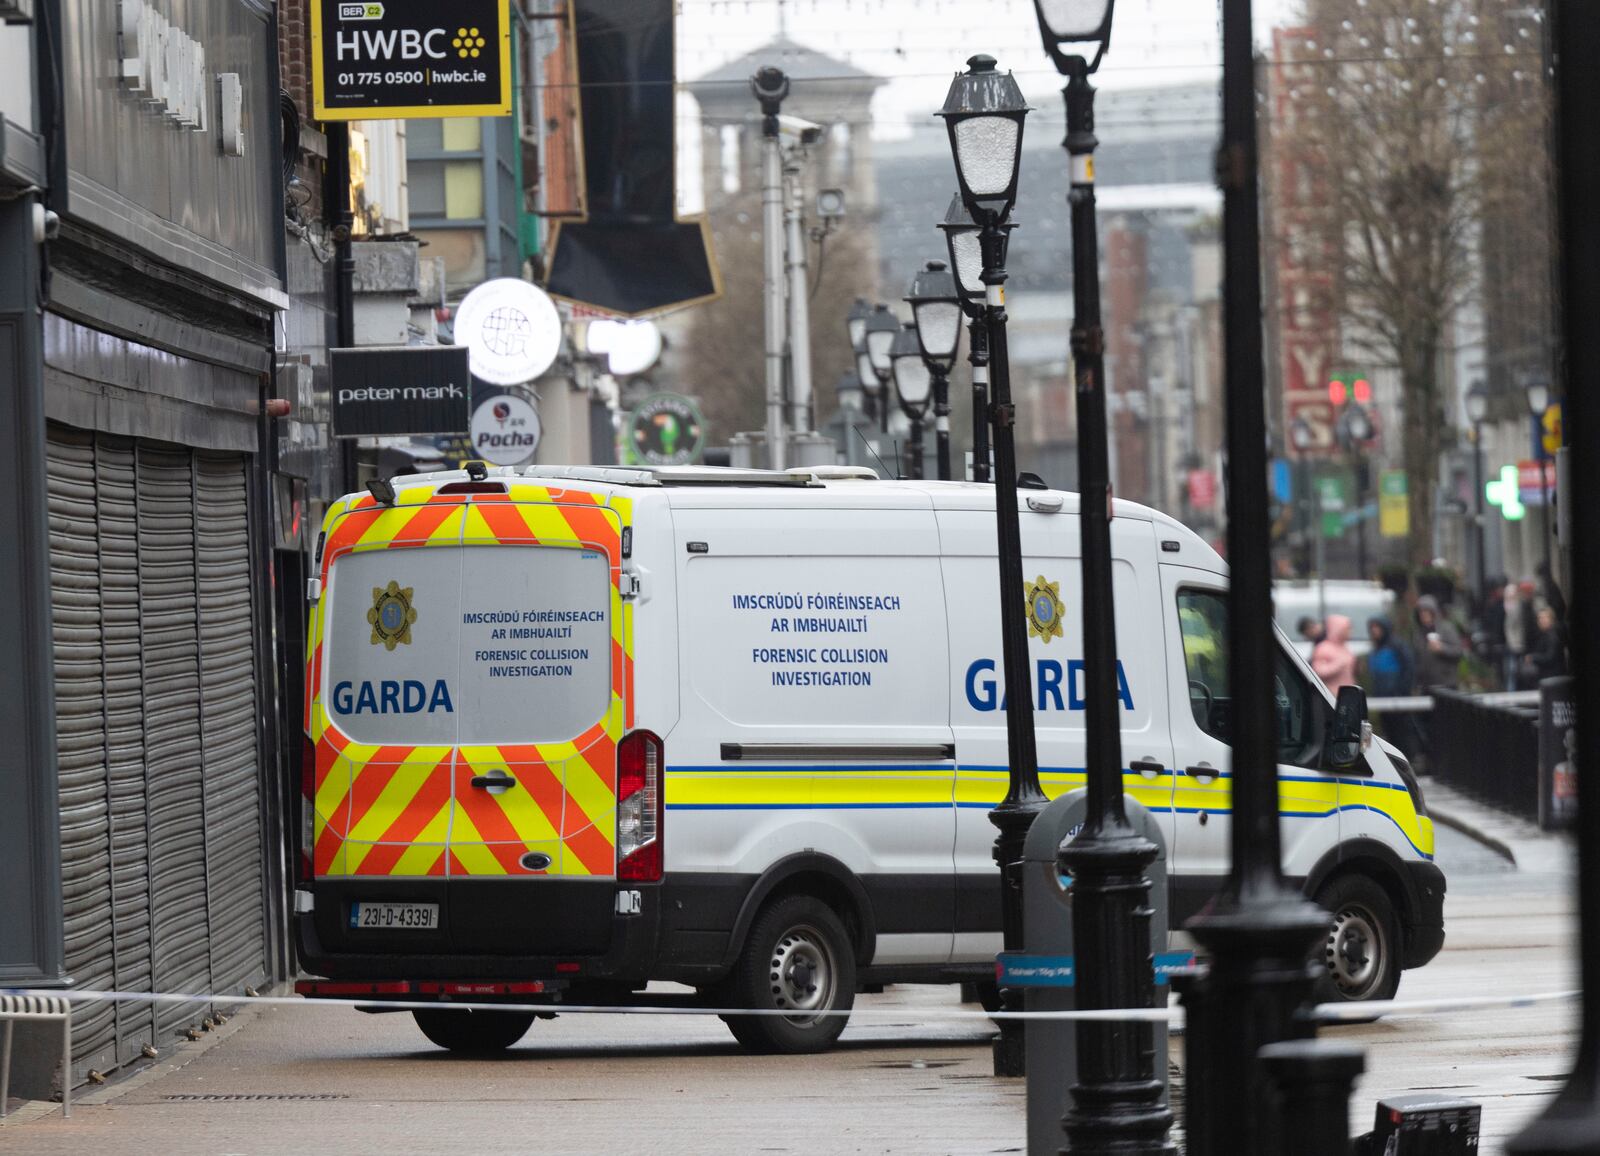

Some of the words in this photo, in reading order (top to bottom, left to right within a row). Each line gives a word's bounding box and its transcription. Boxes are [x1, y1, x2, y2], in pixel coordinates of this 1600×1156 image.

[342, 7, 363, 16] BER
[367, 6, 381, 15] C2
[336, 28, 447, 61] HWBC
[338, 73, 354, 85] 01
[357, 72, 382, 84] 775
[385, 71, 424, 84] 0500
[432, 70, 487, 83] hwbc.ie
[339, 386, 400, 405] peter
[403, 382, 463, 399] mark
[477, 430, 535, 448] Pocha
[732, 591, 803, 609] IMSCRÚDÚ
[807, 592, 901, 610] FÓIRÉINSEACH
[463, 610, 520, 624] IMSCRÚDÚ
[522, 609, 605, 622] FÓIRÉINSEACH
[771, 618, 789, 632] AR
[793, 615, 868, 633] IMBHUAILTÍ
[491, 629, 506, 639] AR
[509, 625, 572, 639] IMBHUAILTÍ
[475, 650, 527, 661] FORENSIC
[529, 649, 589, 660] COLLISION
[752, 648, 817, 663] FORENSIC
[820, 649, 888, 663] COLLISION
[489, 665, 573, 677] INVESTIGATION
[772, 671, 871, 686] INVESTIGATION
[333, 679, 454, 715] GARDA
[363, 908, 433, 926] 231-D-43391
